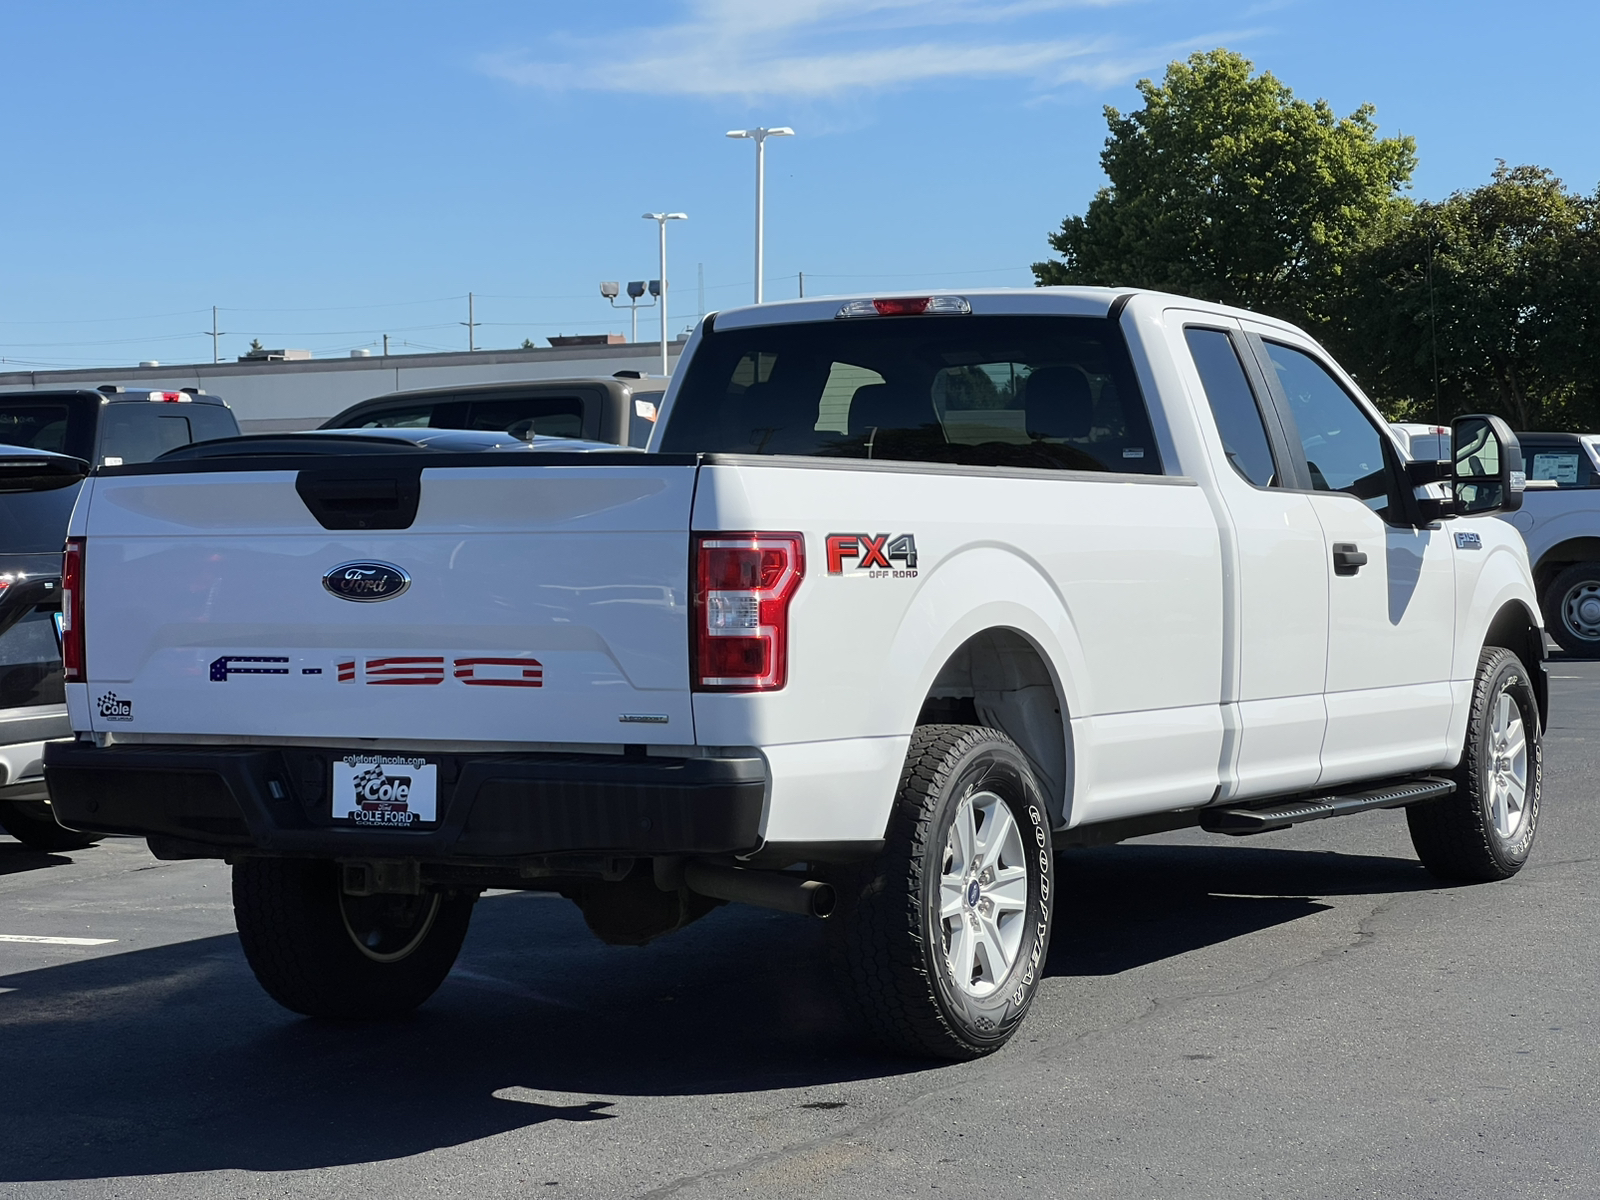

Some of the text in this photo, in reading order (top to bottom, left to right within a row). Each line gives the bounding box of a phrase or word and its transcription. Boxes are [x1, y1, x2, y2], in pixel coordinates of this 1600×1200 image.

[825, 533, 917, 576] FX4
[340, 567, 388, 593] Ford
[869, 570, 918, 578] OFF ROAD
[209, 655, 544, 688] F-150
[102, 702, 130, 715] Cole
[342, 754, 427, 766] colefordlincoln.com
[363, 778, 410, 801] Cole
[353, 810, 414, 823] COLE FORD
[1014, 805, 1050, 1006] GOODYEAR
